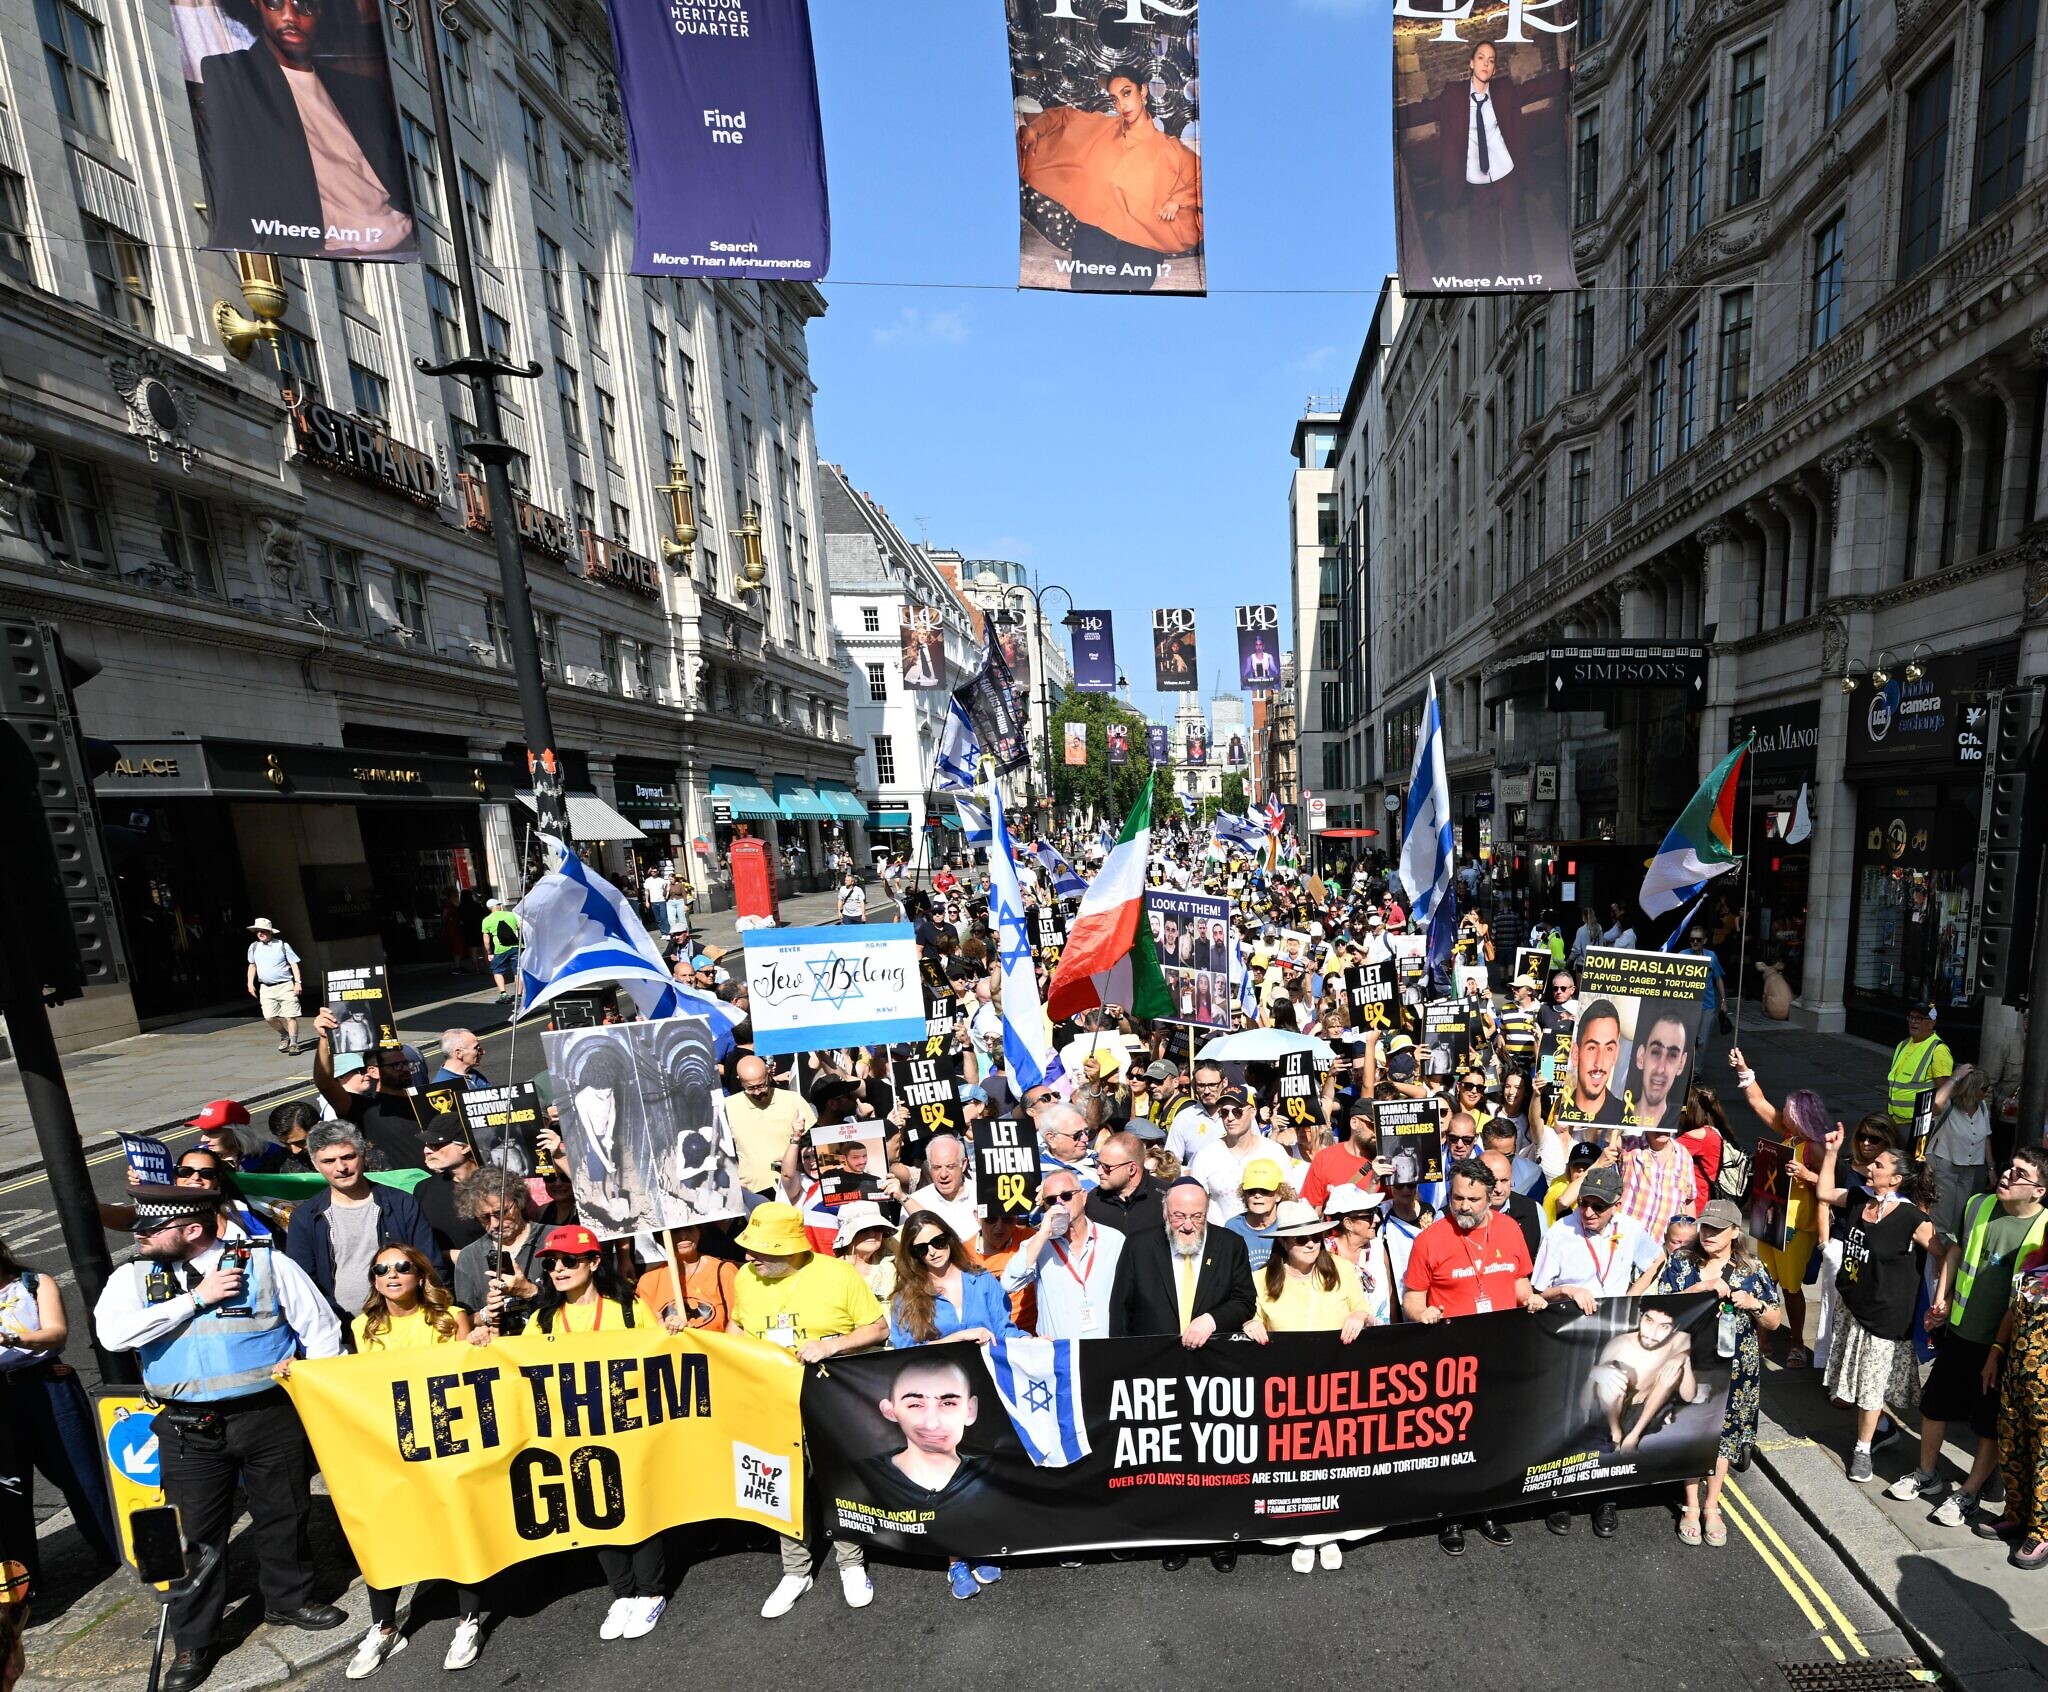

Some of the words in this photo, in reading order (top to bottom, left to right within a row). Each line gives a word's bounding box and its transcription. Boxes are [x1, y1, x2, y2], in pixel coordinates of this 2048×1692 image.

[670, 7, 749, 23] HERITAGE
[675, 21, 750, 37] QUARTER
[704, 109, 746, 128] Find
[712, 129, 744, 145] me
[251, 218, 321, 240] Where
[324, 221, 362, 242] Am
[365, 227, 384, 244] I?
[709, 240, 758, 253] Search
[652, 252, 686, 266] More
[690, 254, 726, 267] Than
[728, 256, 812, 269] Monuments
[1055, 259, 1116, 277] Where
[1120, 261, 1152, 278] Am
[1156, 263, 1172, 278] I?
[1432, 275, 1491, 288] Where
[1494, 276, 1526, 288] Am
[1529, 274, 1543, 288] I?
[310, 403, 442, 497] STRAND
[611, 553, 659, 590] HOTEL
[1152, 608, 1196, 633] LHQ
[1235, 604, 1278, 631] LHQ
[1574, 662, 1686, 682] SIMPSON'S
[1902, 679, 1934, 698] london
[1900, 697, 1941, 714] camera
[994, 706, 1009, 734] BEHIND
[1899, 714, 1945, 733] exchange
[114, 758, 178, 774] ALACE
[636, 784, 664, 800] Daymart
[1152, 898, 1177, 912] LOOK
[1178, 901, 1190, 912] AT
[1190, 902, 1221, 916] THEM!
[1039, 919, 1054, 932] LET
[823, 956, 905, 992] Belong
[1359, 964, 1382, 986] LET
[1585, 956, 1616, 970] ROM
[1620, 958, 1708, 978] BRASLAVSKI
[328, 979, 365, 992] STARVING
[1583, 972, 1622, 982] STARVED
[1629, 976, 1656, 986] CAGED
[1665, 979, 1706, 990] TORTURED
[328, 992, 342, 1002] THE
[342, 988, 382, 1000] HOSTAGES
[1352, 982, 1392, 1006] THEM
[1590, 983, 1602, 991] BY
[1605, 984, 1626, 994] YOUR
[1629, 986, 1660, 997] HEROES
[1662, 990, 1670, 998] IN
[1672, 991, 1694, 1000] GAZA
[932, 998, 948, 1018] LET
[926, 1016, 954, 1037] THEM
[910, 1060, 936, 1083] LET
[1286, 1054, 1302, 1076] LET
[462, 1088, 500, 1104] HAMAS
[904, 1080, 953, 1106] THEM
[1280, 1074, 1311, 1098] THEM
[468, 1116, 488, 1128] THE
[487, 1109, 536, 1126] HOSAGES
[1379, 1104, 1408, 1115] HAMAS
[1409, 1102, 1424, 1112] ARE
[1560, 1110, 1582, 1120] AGE
[1380, 1114, 1418, 1126] STARVING
[1380, 1126, 1394, 1136] THE
[1396, 1122, 1434, 1136] HOSTAGES
[1622, 1115, 1640, 1124] AGE
[990, 1121, 1018, 1147] LET
[126, 1140, 166, 1156] STAND
[132, 1154, 164, 1170] WITH
[982, 1148, 1034, 1174] THEM
[137, 1170, 170, 1185] SRAEL
[1849, 1226, 1866, 1246] LET
[1844, 1240, 1870, 1264] THEM
[766, 1313, 800, 1328] LT
[1108, 1378, 1178, 1422] ARE
[1179, 1376, 1256, 1419] YOU
[1264, 1360, 1428, 1418] CLUELESS
[1435, 1356, 1479, 1398] OR
[391, 1366, 500, 1462] LET
[518, 1353, 712, 1438] THEM
[1114, 1423, 1182, 1470] ARE
[1184, 1423, 1258, 1464] YOU
[1268, 1400, 1474, 1462] HEARTLESS?
[1108, 1475, 1134, 1488] OVER
[1136, 1473, 1156, 1486] 670
[1158, 1472, 1185, 1486] DAYS!
[1186, 1474, 1200, 1486] 50
[1202, 1474, 1250, 1487] HOSTAGES
[1252, 1472, 1272, 1484] ARE
[1272, 1470, 1299, 1483] STILL
[1300, 1468, 1328, 1482] BEING
[1329, 1466, 1371, 1480] STARVED
[1372, 1464, 1392, 1476] AND
[1392, 1457, 1439, 1474] TORTURED
[1440, 1455, 1450, 1468] IN
[1451, 1451, 1477, 1466] GAZA.
[1524, 1470, 1559, 1485] STARVED.
[1561, 1459, 1600, 1476] TORTURED.
[1526, 1459, 1562, 1476] EVYATAR
[1562, 1452, 1586, 1467] DAVID
[748, 1472, 776, 1493] THE
[1522, 1482, 1552, 1494] FORCED
[1552, 1477, 1562, 1487] TO
[1563, 1474, 1576, 1484] DIG
[1576, 1470, 1590, 1482] HIS
[1590, 1468, 1610, 1480] OWN
[1610, 1464, 1638, 1477] GRAVE.
[509, 1445, 626, 1541] GO
[744, 1484, 780, 1507] HATE
[836, 1498, 857, 1512] ROM
[858, 1503, 917, 1523] BRASLAVSKI
[920, 1510, 936, 1522] (22)
[1267, 1504, 1297, 1514] FAMILIES
[1298, 1502, 1321, 1512] FORUM
[1322, 1494, 1340, 1510] UK
[837, 1508, 878, 1526] STARVED.
[878, 1518, 928, 1534] TORTURED.
[839, 1518, 876, 1535] BROKEN.
